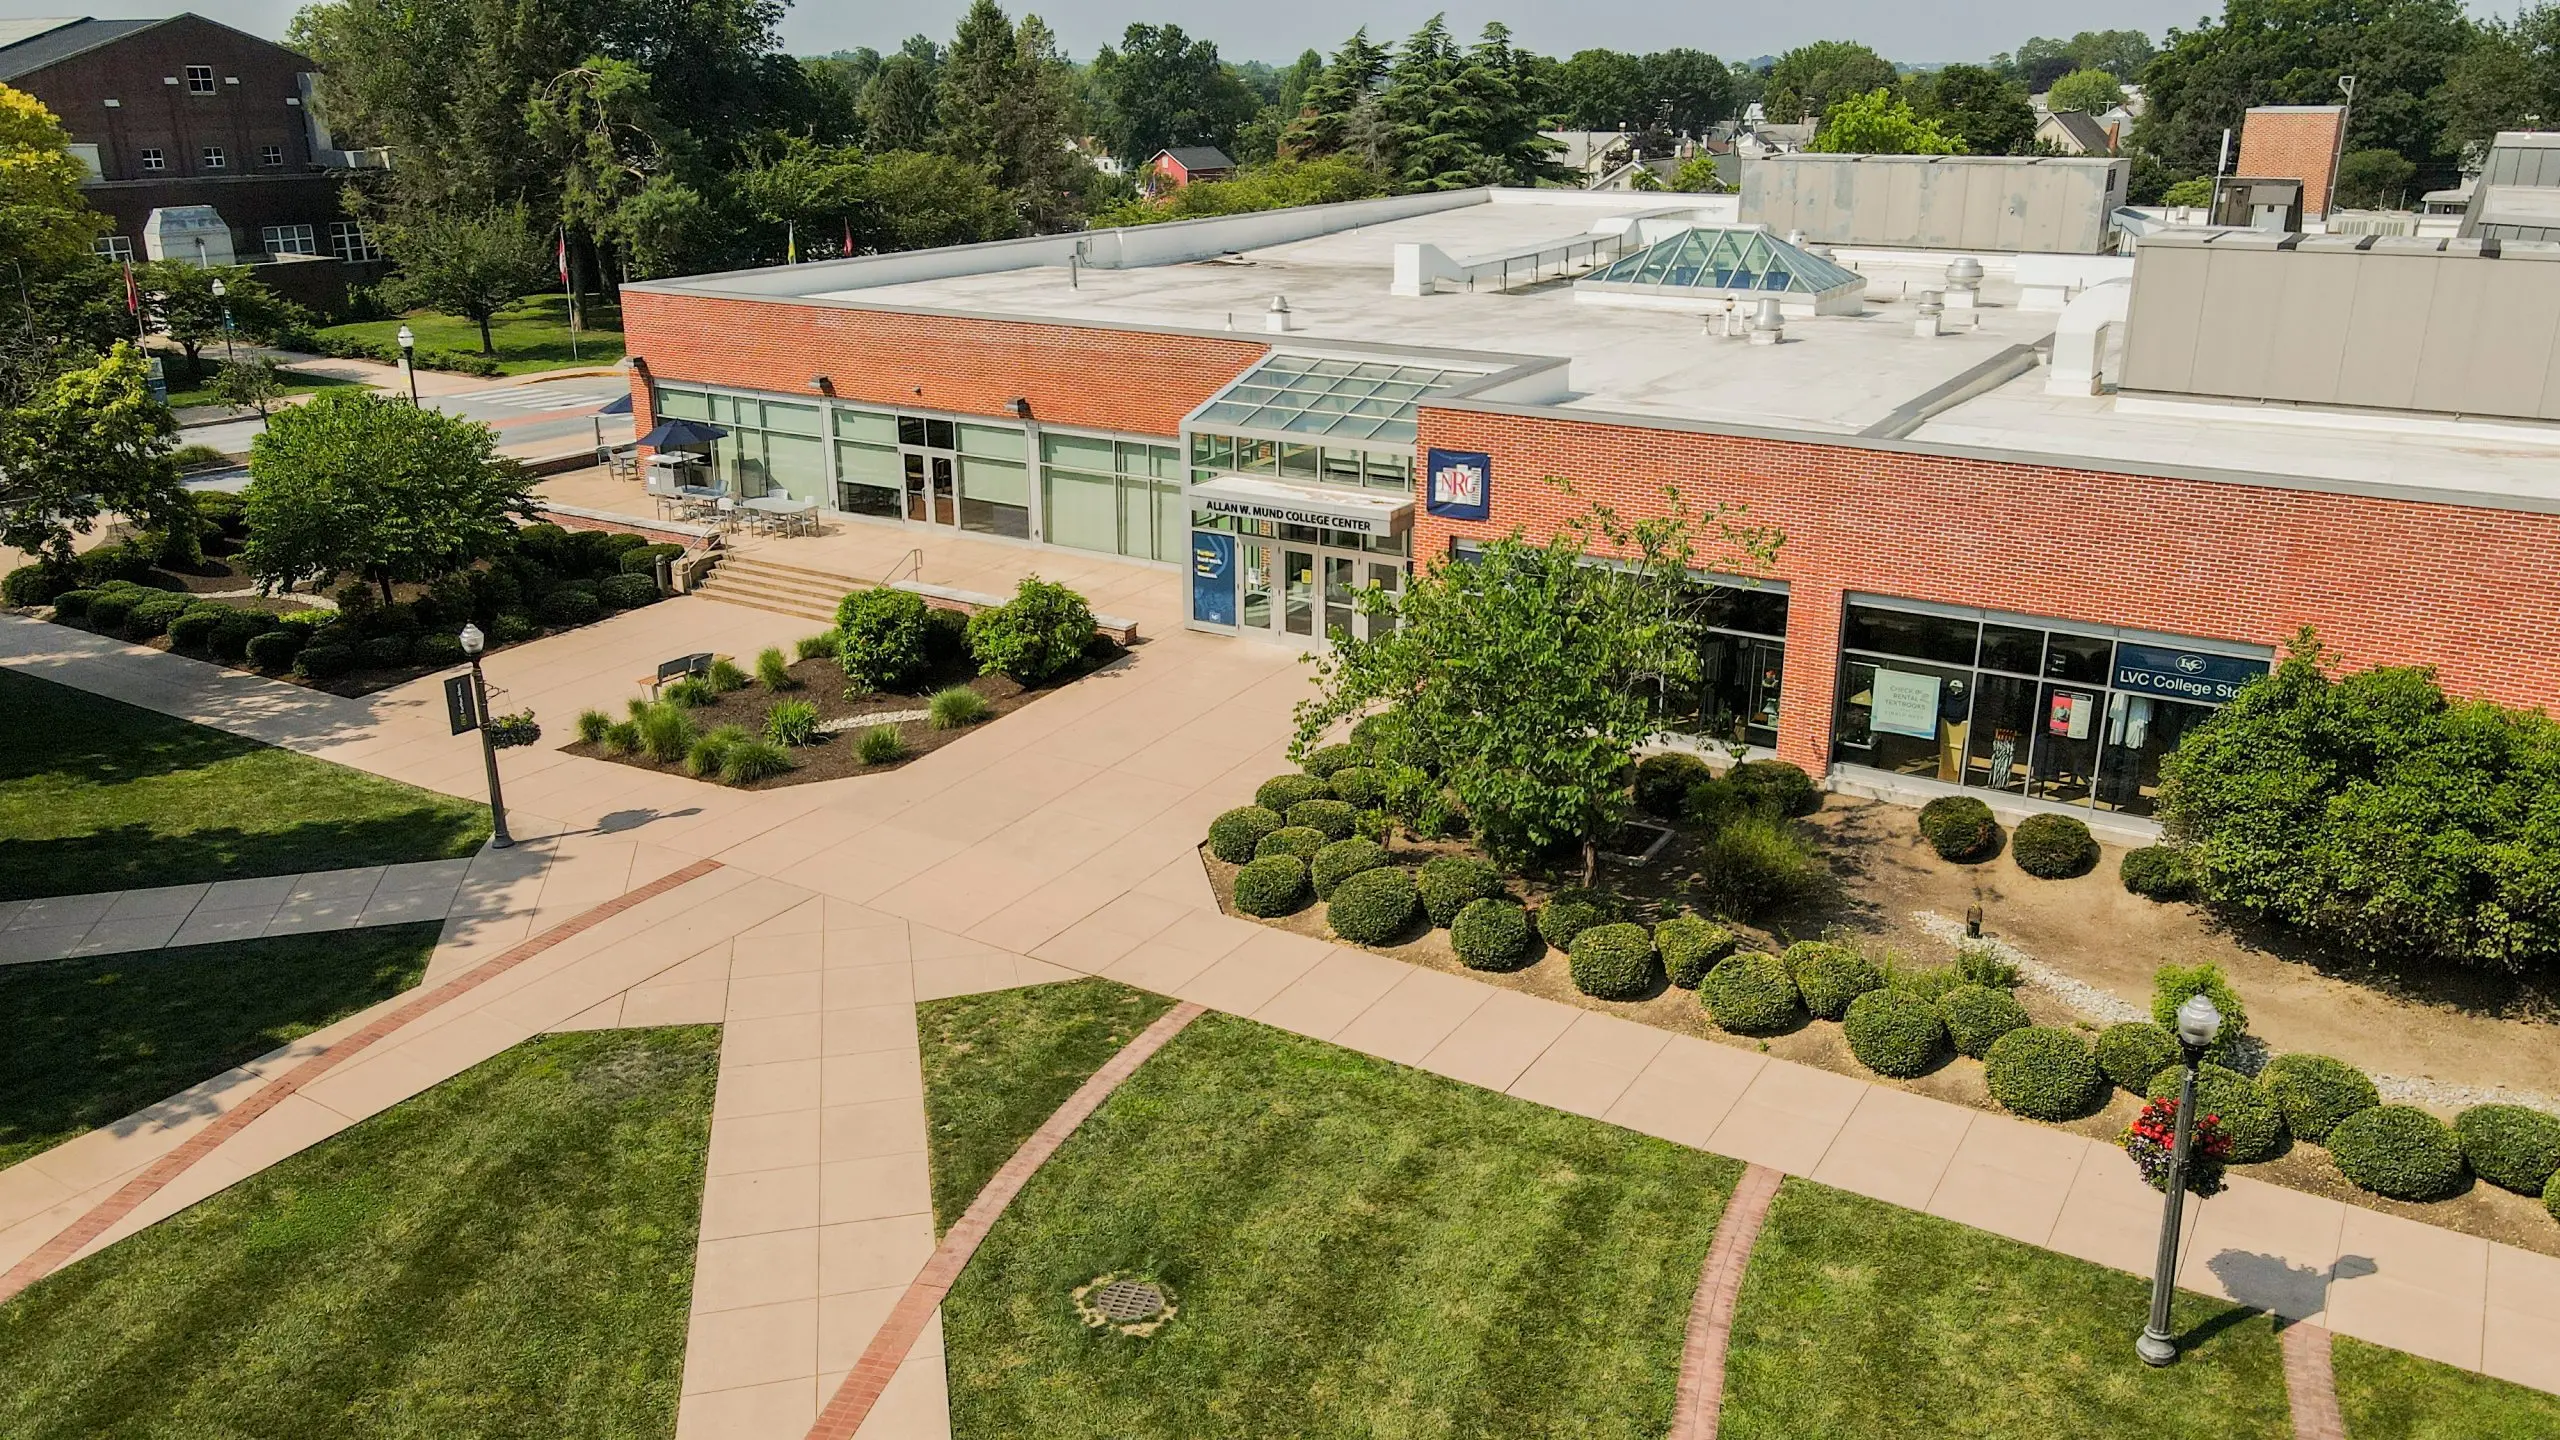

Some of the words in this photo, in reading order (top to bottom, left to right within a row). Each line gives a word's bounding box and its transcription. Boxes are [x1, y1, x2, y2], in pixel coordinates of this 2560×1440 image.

[1441, 471, 1476, 496] NRG
[1206, 500, 1238, 513] ALLAN
[1239, 504, 1251, 515] W.
[1253, 506, 1284, 519] MUND
[1285, 511, 1330, 526] COLLEGE
[1331, 516, 1371, 531] CENTER
[2120, 670, 2150, 686] LVC
[2153, 675, 2212, 696] College
[2215, 684, 2245, 699] Sto
